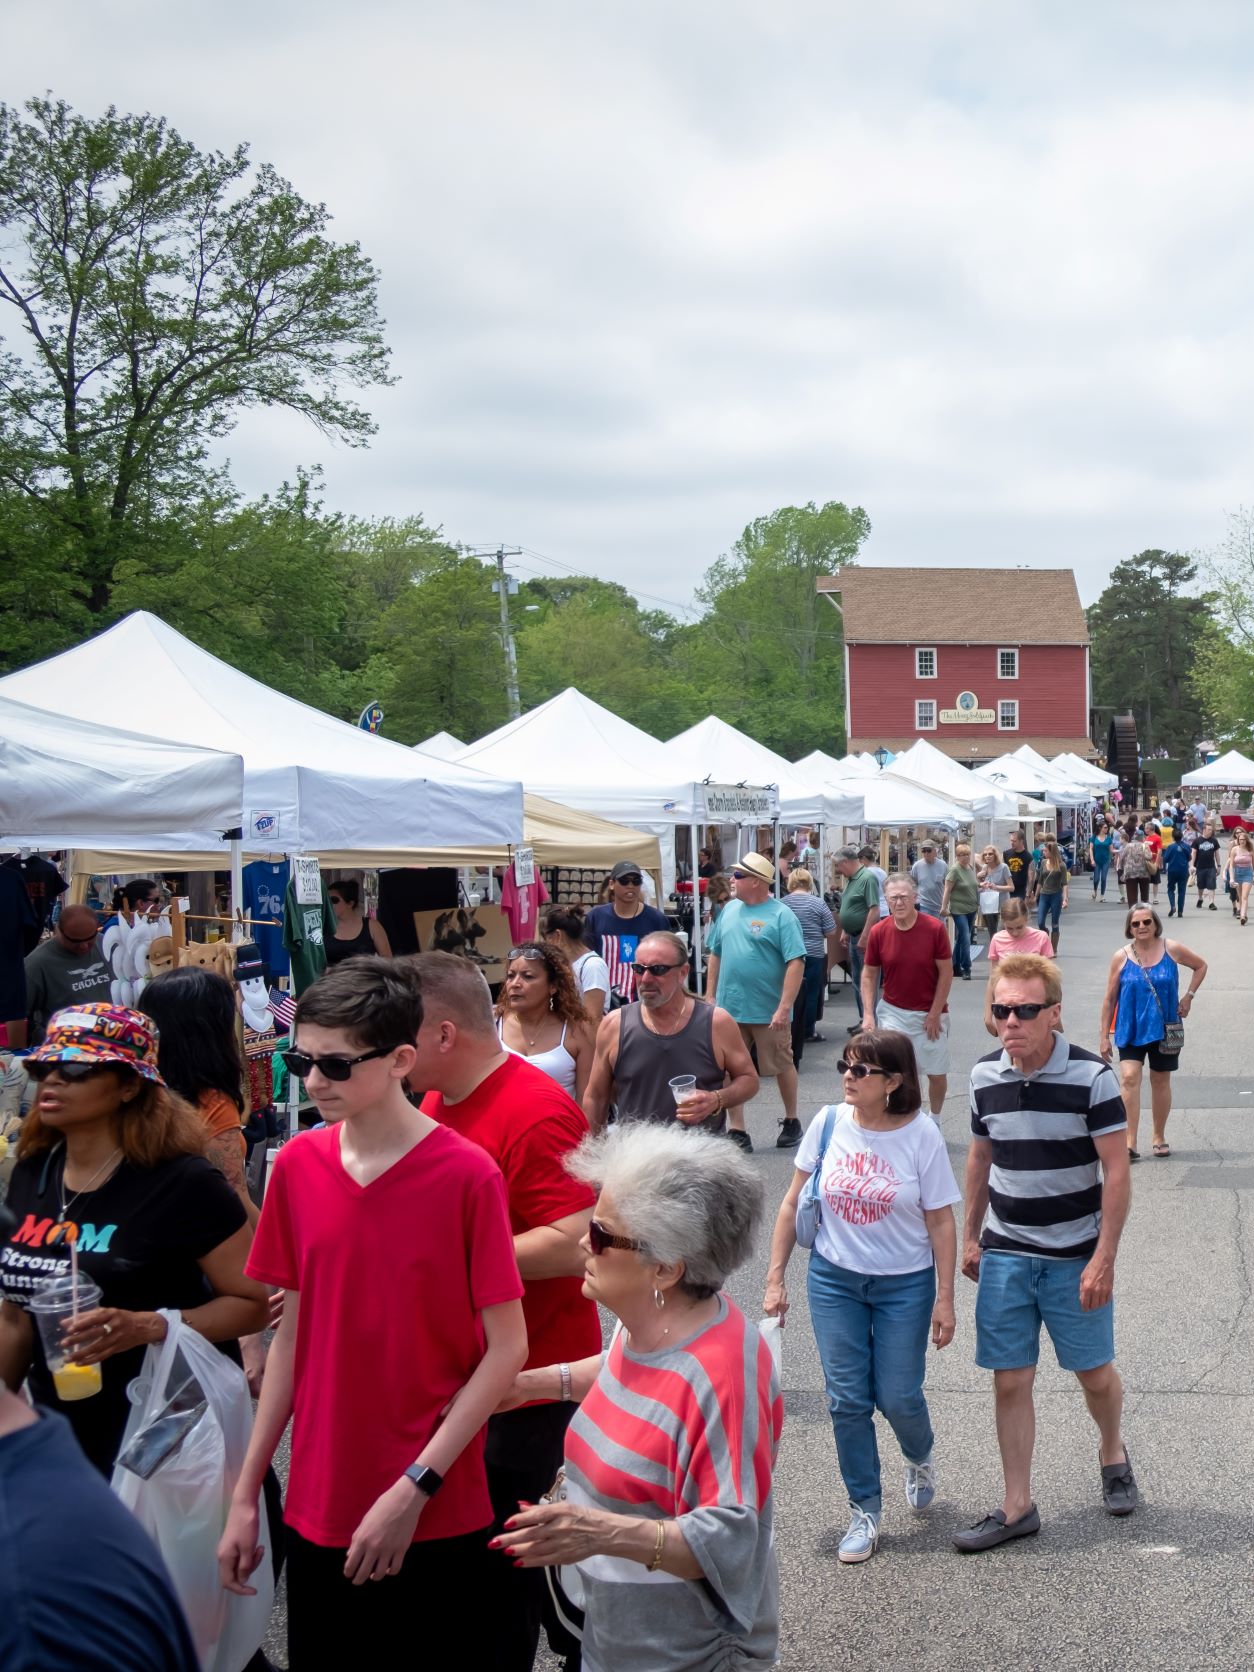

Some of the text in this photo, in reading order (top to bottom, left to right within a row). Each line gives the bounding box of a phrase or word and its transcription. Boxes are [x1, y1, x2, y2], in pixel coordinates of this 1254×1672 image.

[71, 973, 111, 992] EAGLES
[836, 1151, 895, 1177] ALWAYS
[11, 1214, 118, 1253] MOM
[0, 1247, 71, 1276] Strong
